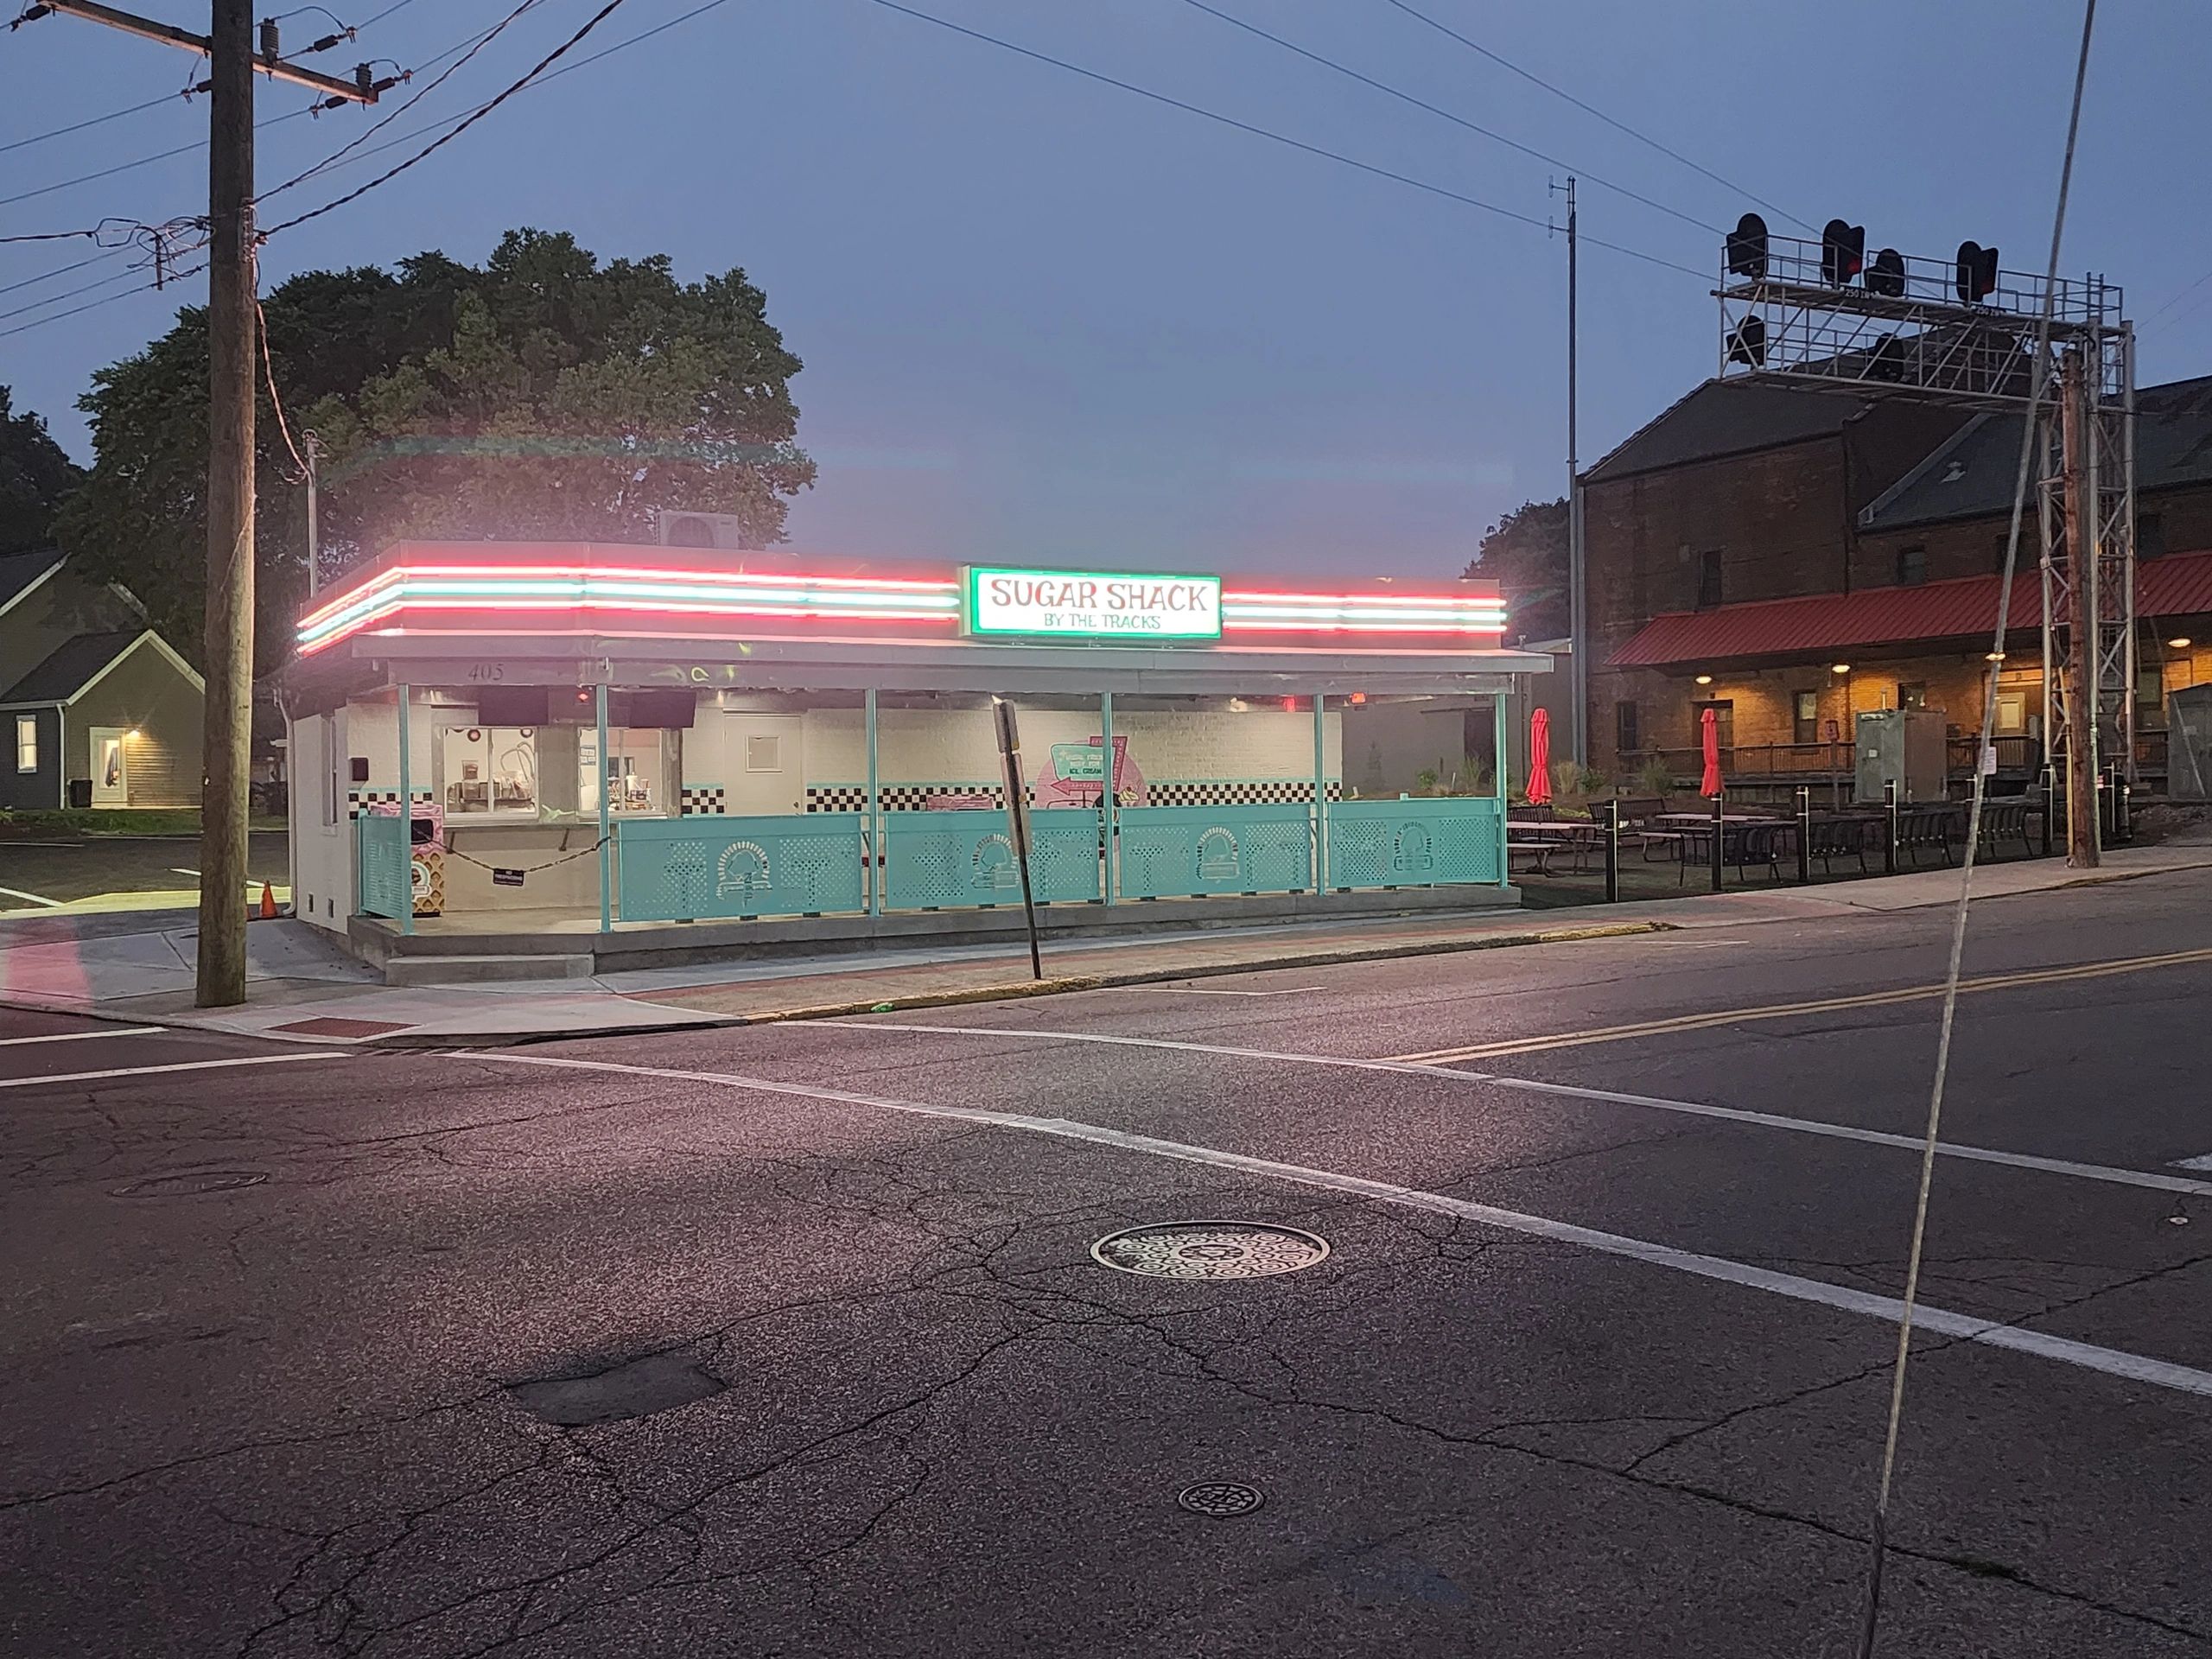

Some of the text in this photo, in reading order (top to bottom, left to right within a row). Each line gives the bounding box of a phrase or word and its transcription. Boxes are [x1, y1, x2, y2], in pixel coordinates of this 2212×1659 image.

[991, 578, 1208, 611] SUGAR SHACK
[1044, 613, 1161, 630] BY THE TRACKS
[467, 663, 505, 682] 405
